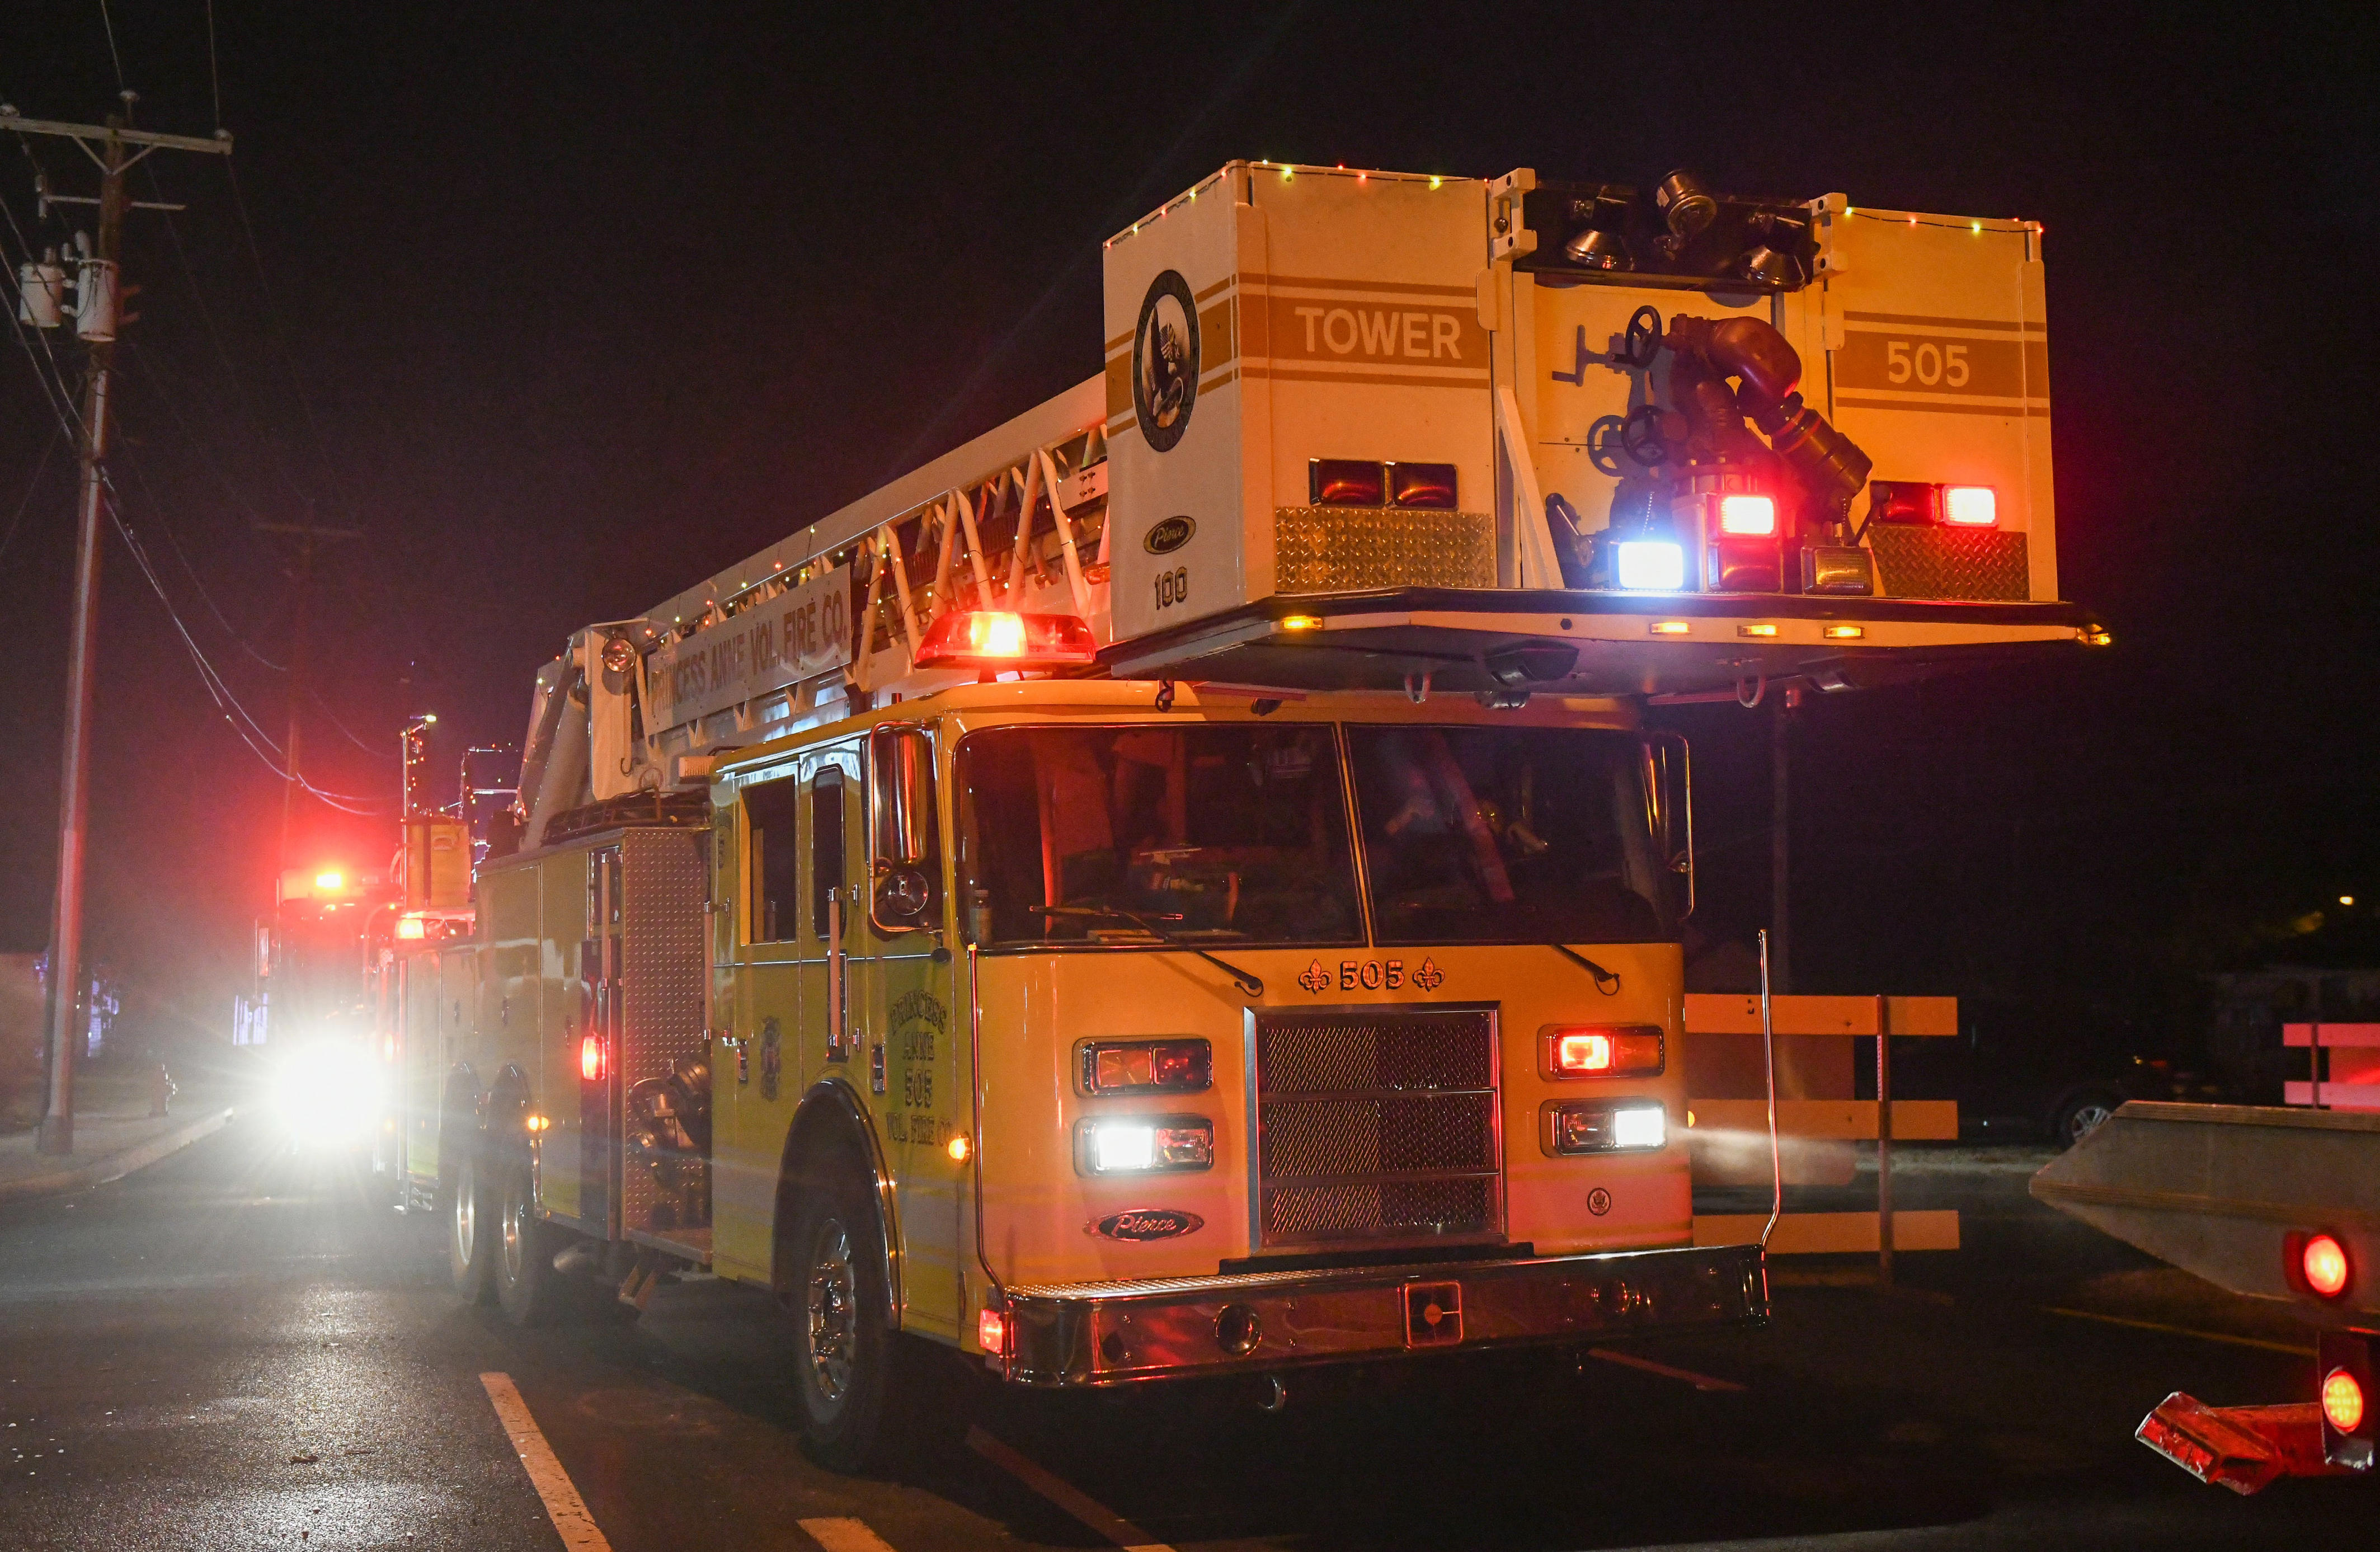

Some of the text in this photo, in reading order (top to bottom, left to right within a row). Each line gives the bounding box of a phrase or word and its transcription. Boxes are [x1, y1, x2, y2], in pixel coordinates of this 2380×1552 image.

[1295, 306, 1462, 359] TOWER
[1888, 341, 1969, 387] 505
[1155, 566, 1188, 610] 100
[710, 633, 746, 693] ANNE
[750, 619, 781, 675] VOL.
[783, 601, 816, 664] FIRE
[822, 590, 848, 648] CO.
[1340, 960, 1405, 991] 505
[890, 989, 947, 1035] PRINCESS
[903, 1032, 935, 1061] ANNE
[905, 1069, 932, 1108] 505
[910, 1114, 935, 1146] FIRE
[1111, 1214, 1177, 1236] Pierce
